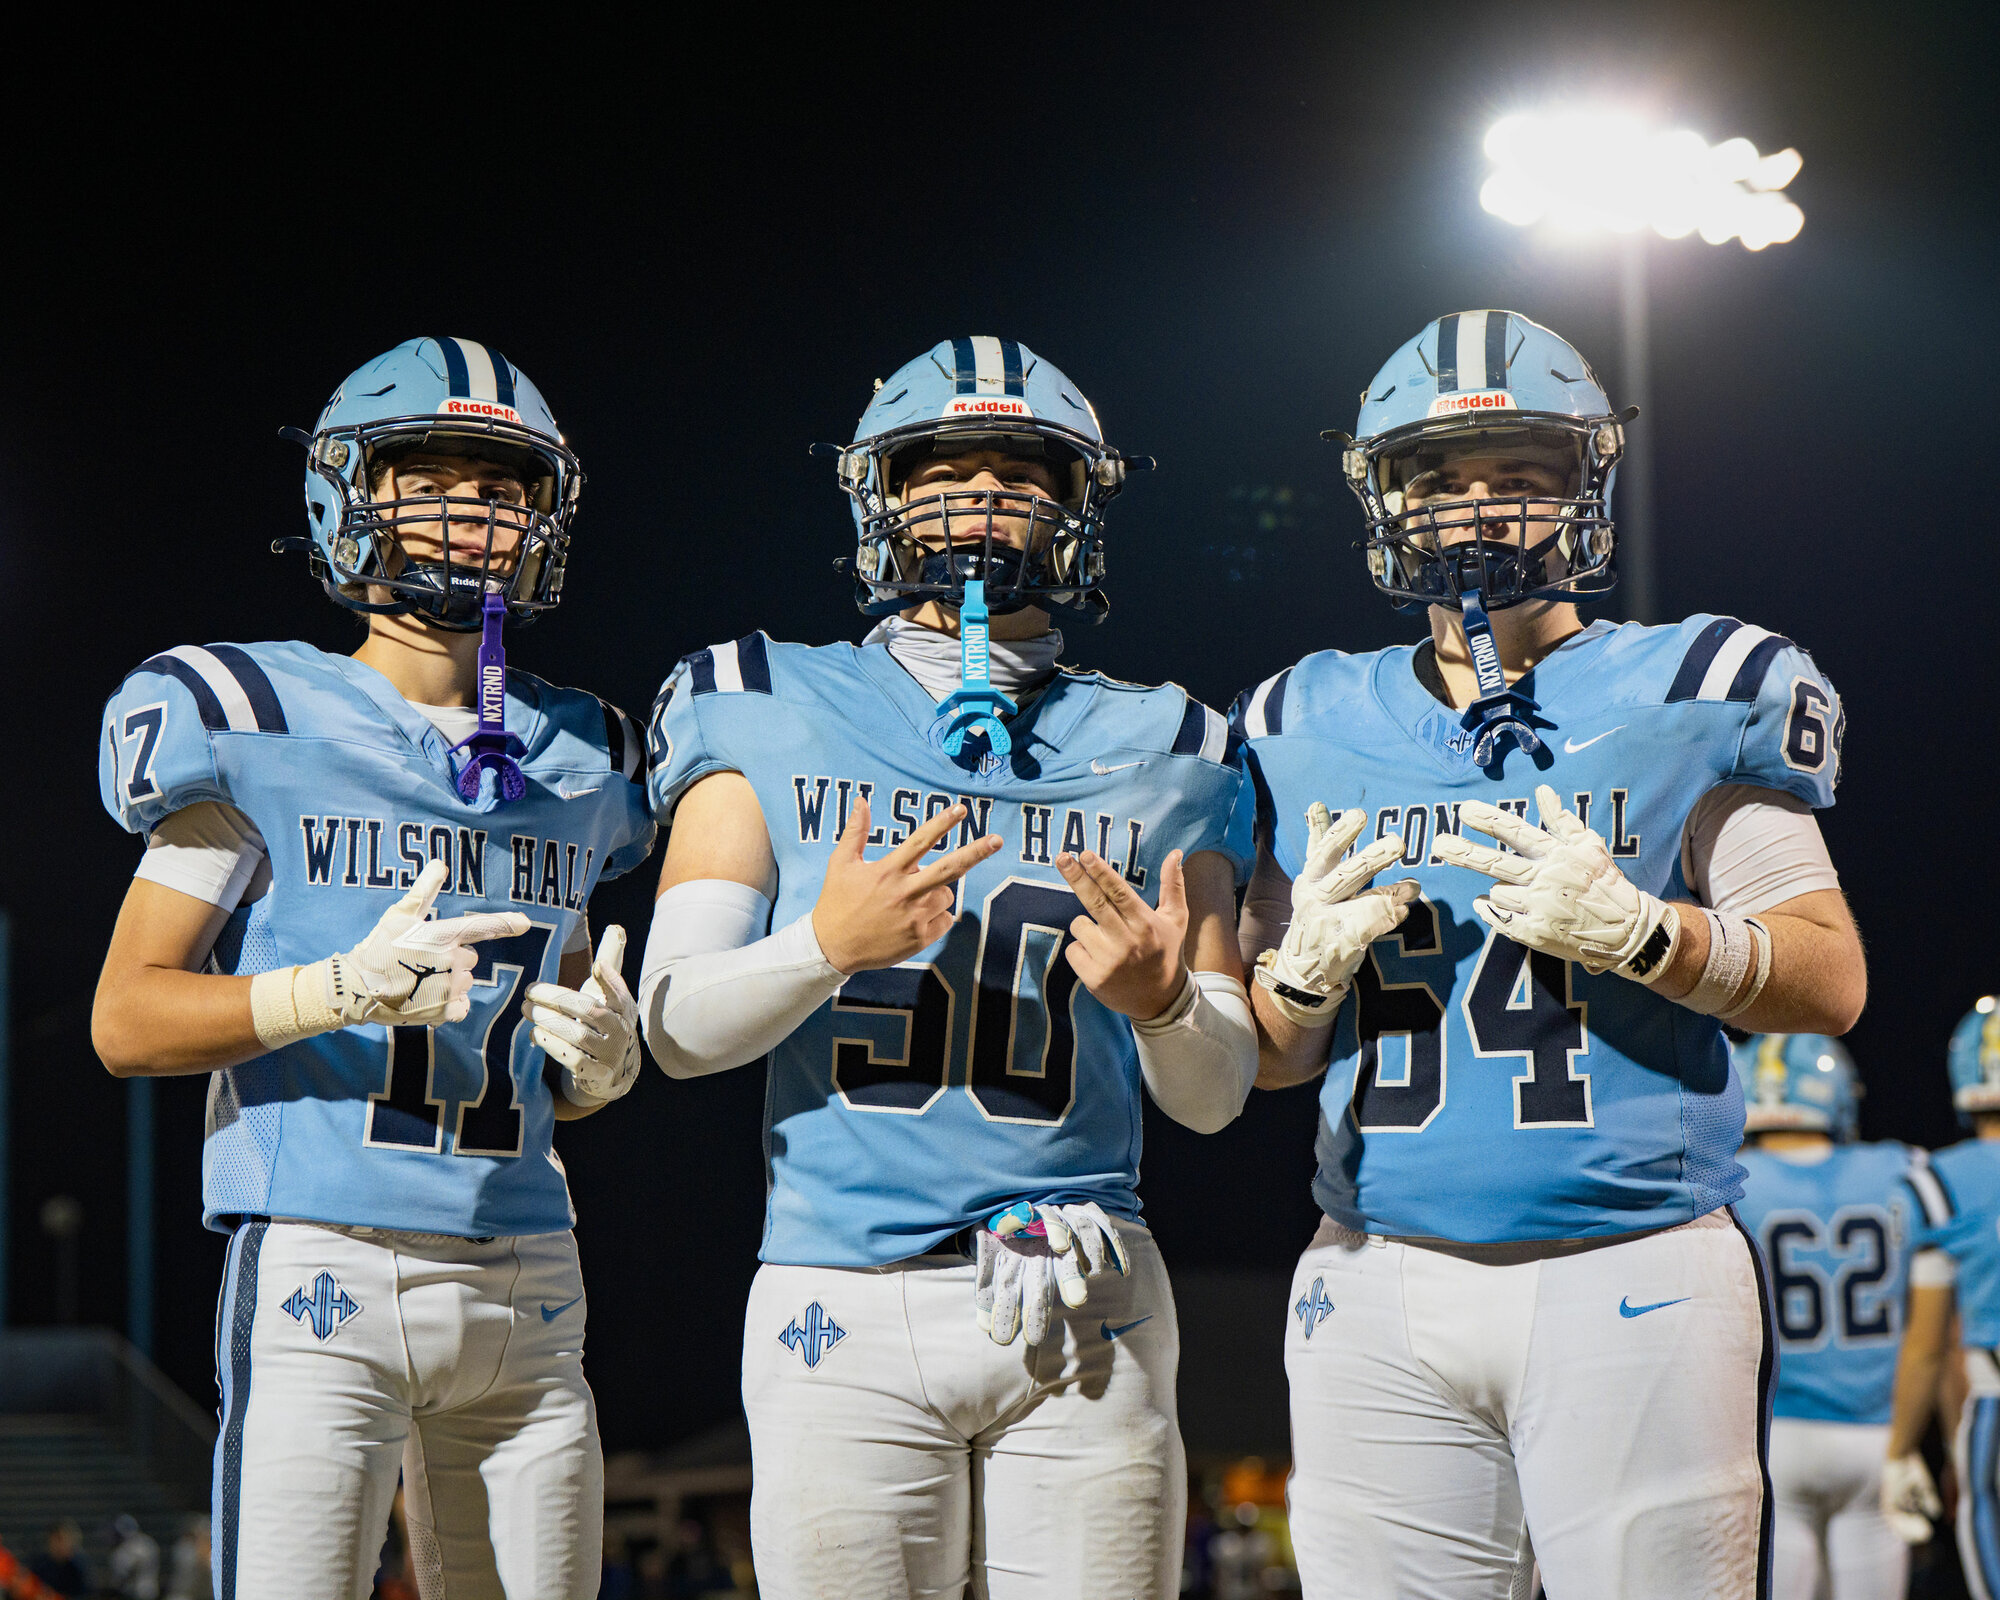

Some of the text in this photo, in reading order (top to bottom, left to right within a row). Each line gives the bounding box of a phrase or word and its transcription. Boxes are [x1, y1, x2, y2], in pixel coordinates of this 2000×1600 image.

[447, 400, 515, 422] Riddell
[953, 400, 1023, 414] Riddell
[1436, 394, 1506, 414] Riddell
[451, 576, 480, 588] Ridde
[964, 625, 987, 680] NXTRND
[1470, 633, 1502, 691] NXTRND
[482, 665, 503, 723] NXTRND
[108, 700, 168, 819] 17
[299, 814, 595, 914] WILSON HALL
[791, 774, 1148, 890] WILSON HALL
[362, 906, 560, 1158] 17
[830, 865, 1088, 1128] 50
[1349, 878, 1596, 1132] 64
[1762, 1206, 1899, 1352] 62
